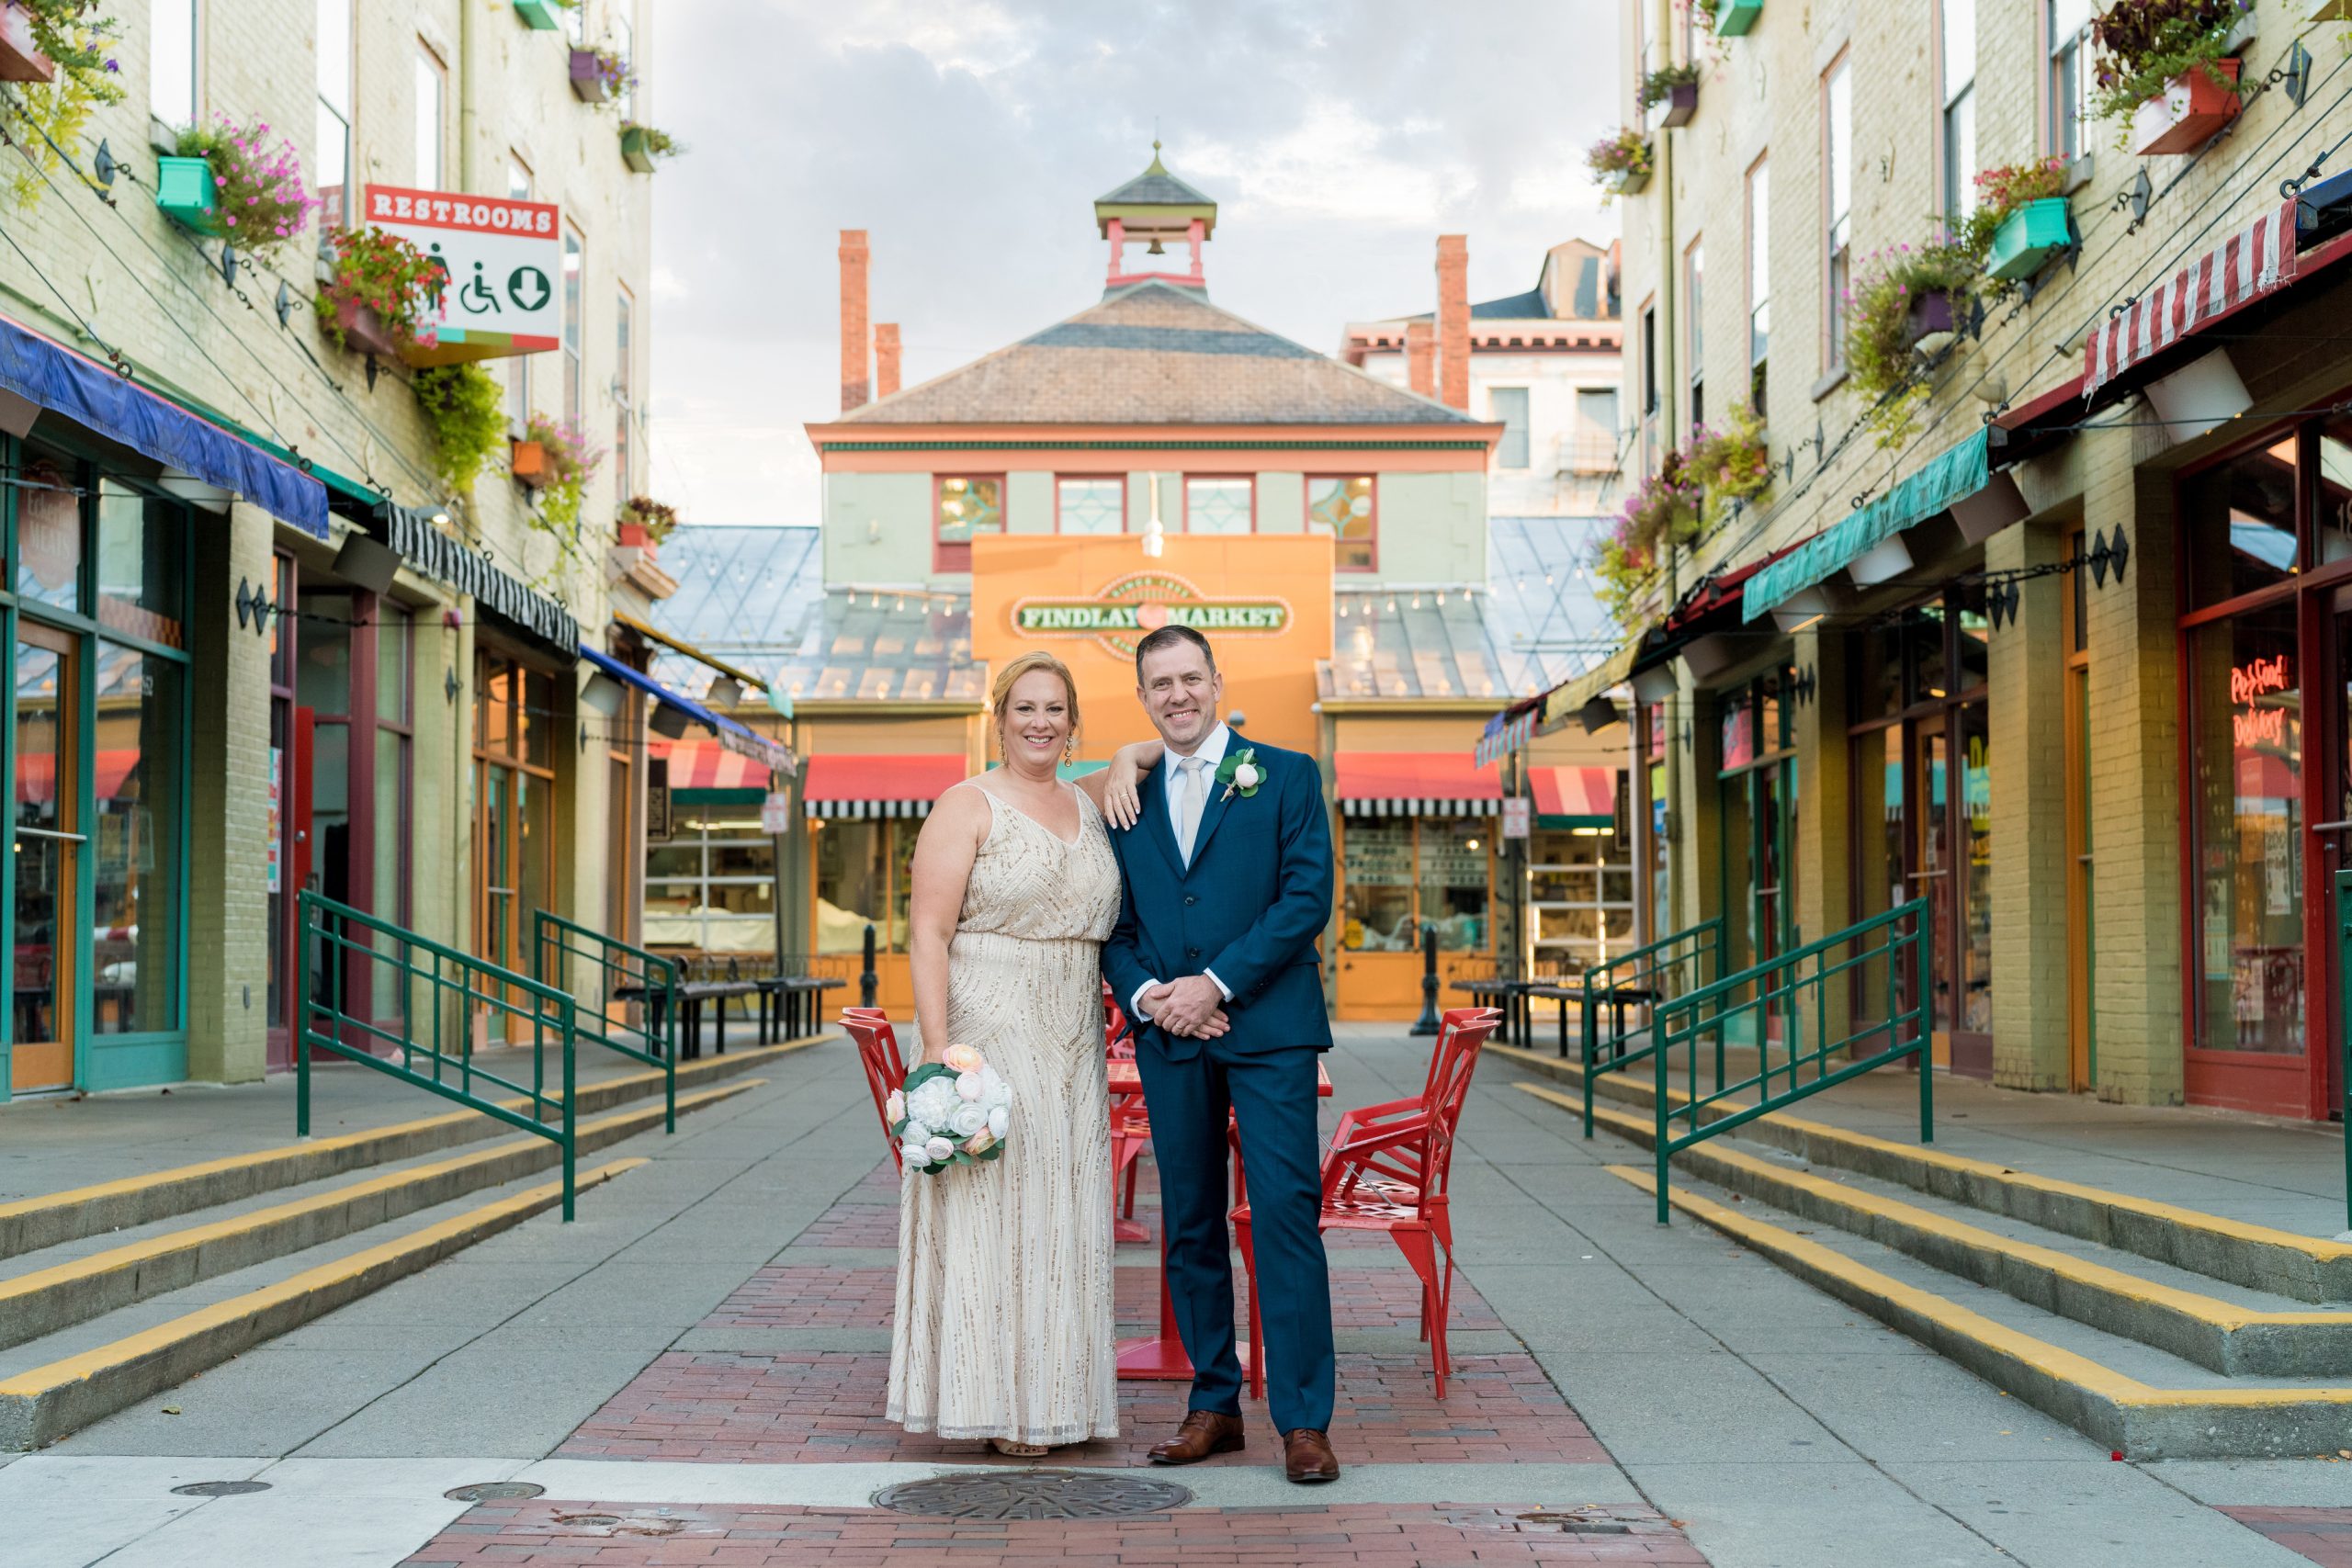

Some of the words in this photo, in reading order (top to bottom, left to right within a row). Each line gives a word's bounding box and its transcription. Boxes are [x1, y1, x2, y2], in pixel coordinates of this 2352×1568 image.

[373, 193, 552, 233] RESTROOMS
[1023, 607, 1137, 627] FINDLAY
[1166, 607, 1283, 627] MARKET
[2255, 654, 2284, 694] Food
[2233, 706, 2285, 747] Delivery
